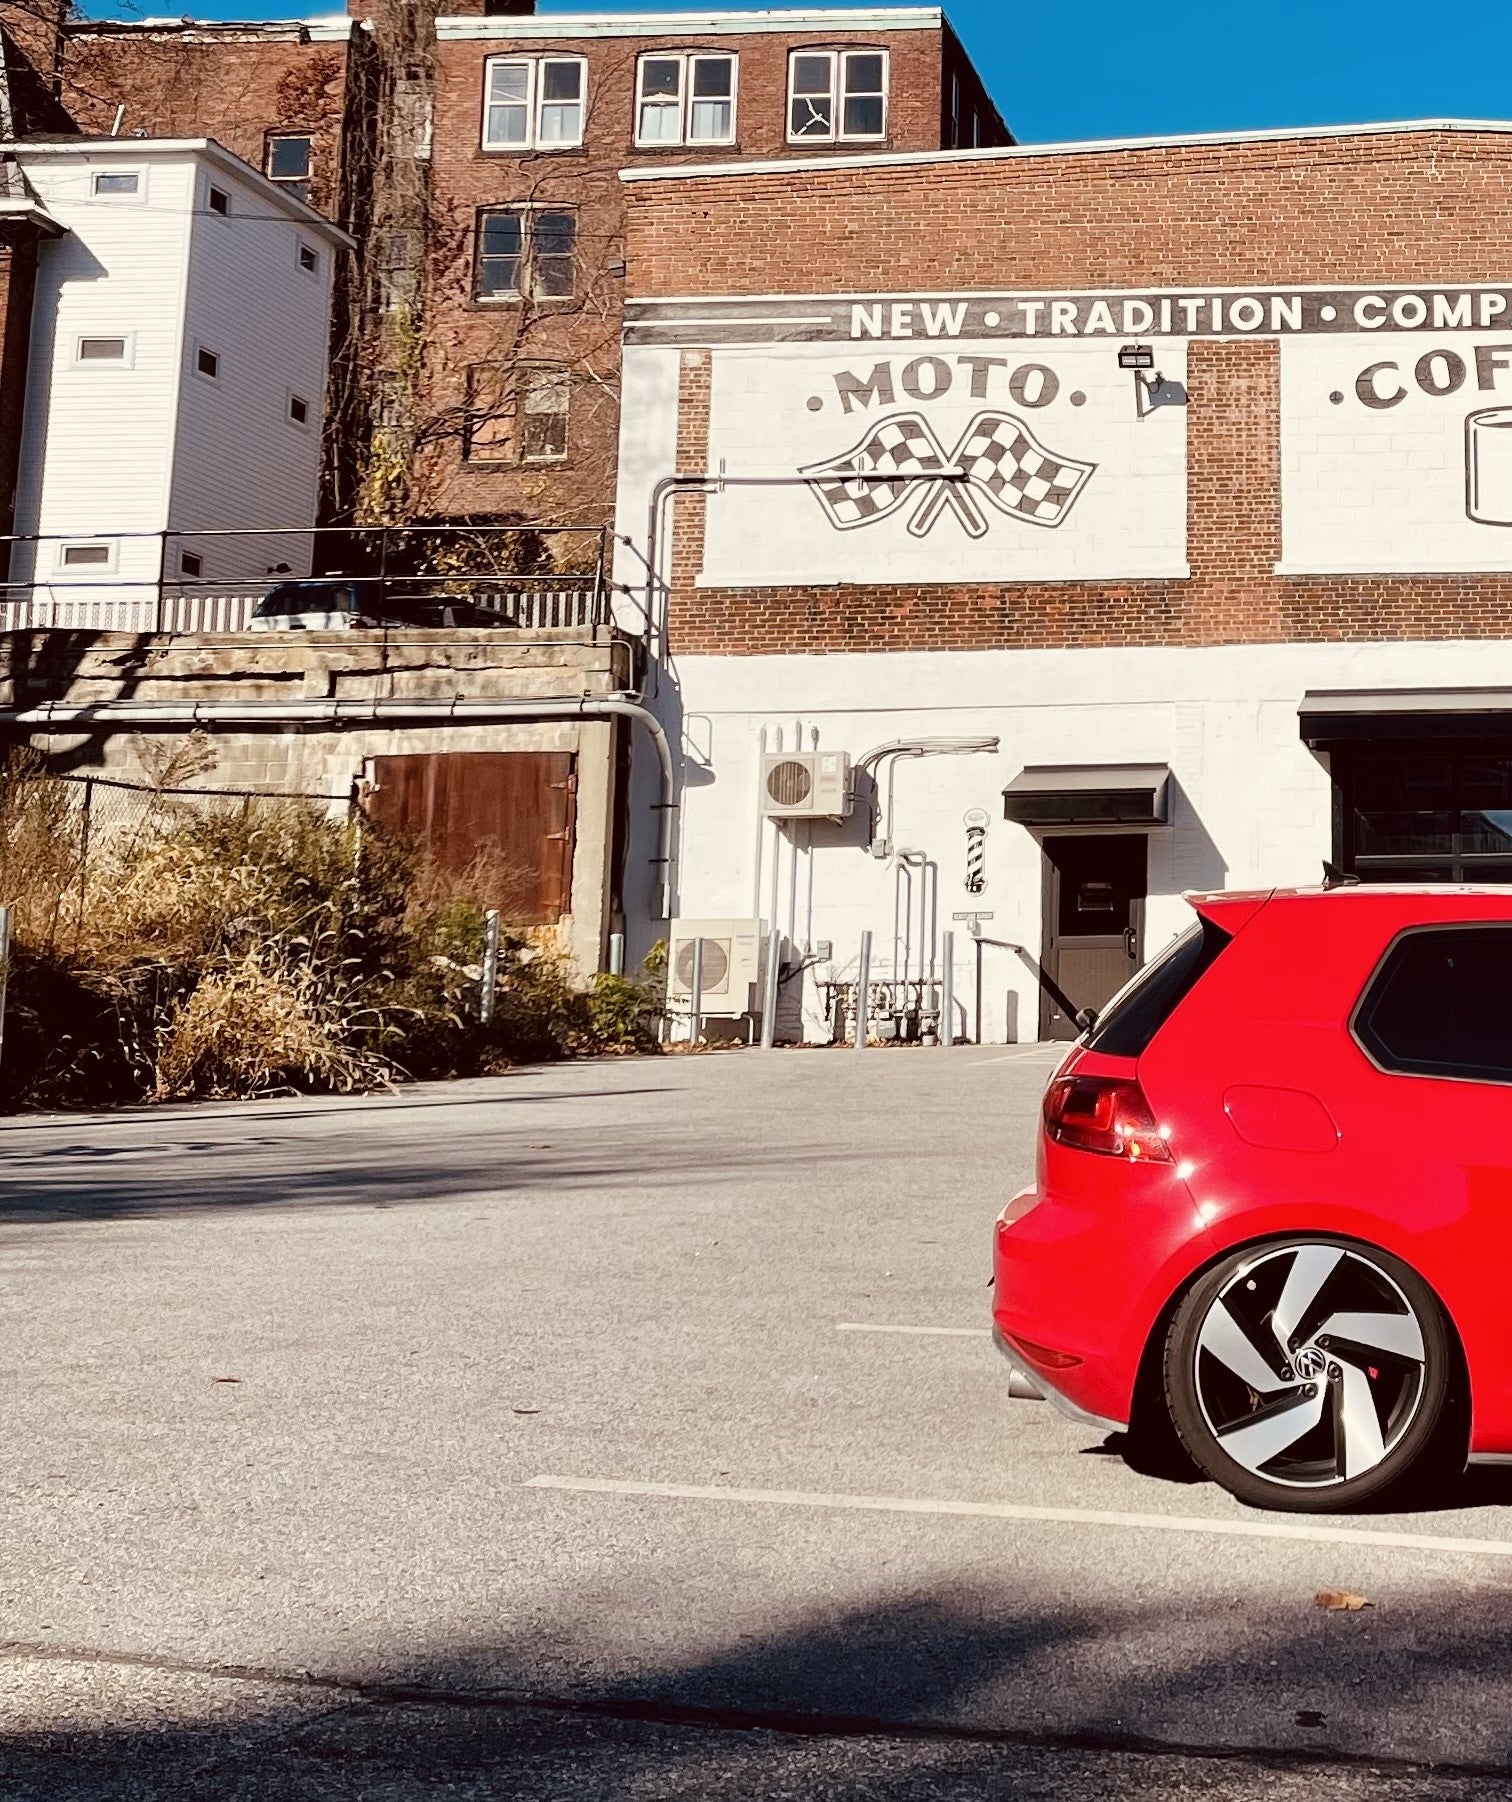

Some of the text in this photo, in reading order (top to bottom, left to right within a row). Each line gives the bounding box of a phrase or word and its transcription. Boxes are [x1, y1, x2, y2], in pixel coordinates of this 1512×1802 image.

[850, 302, 968, 337] NEW
[1017, 297, 1301, 335] TRADITION
[832, 356, 1059, 414] MOTO
